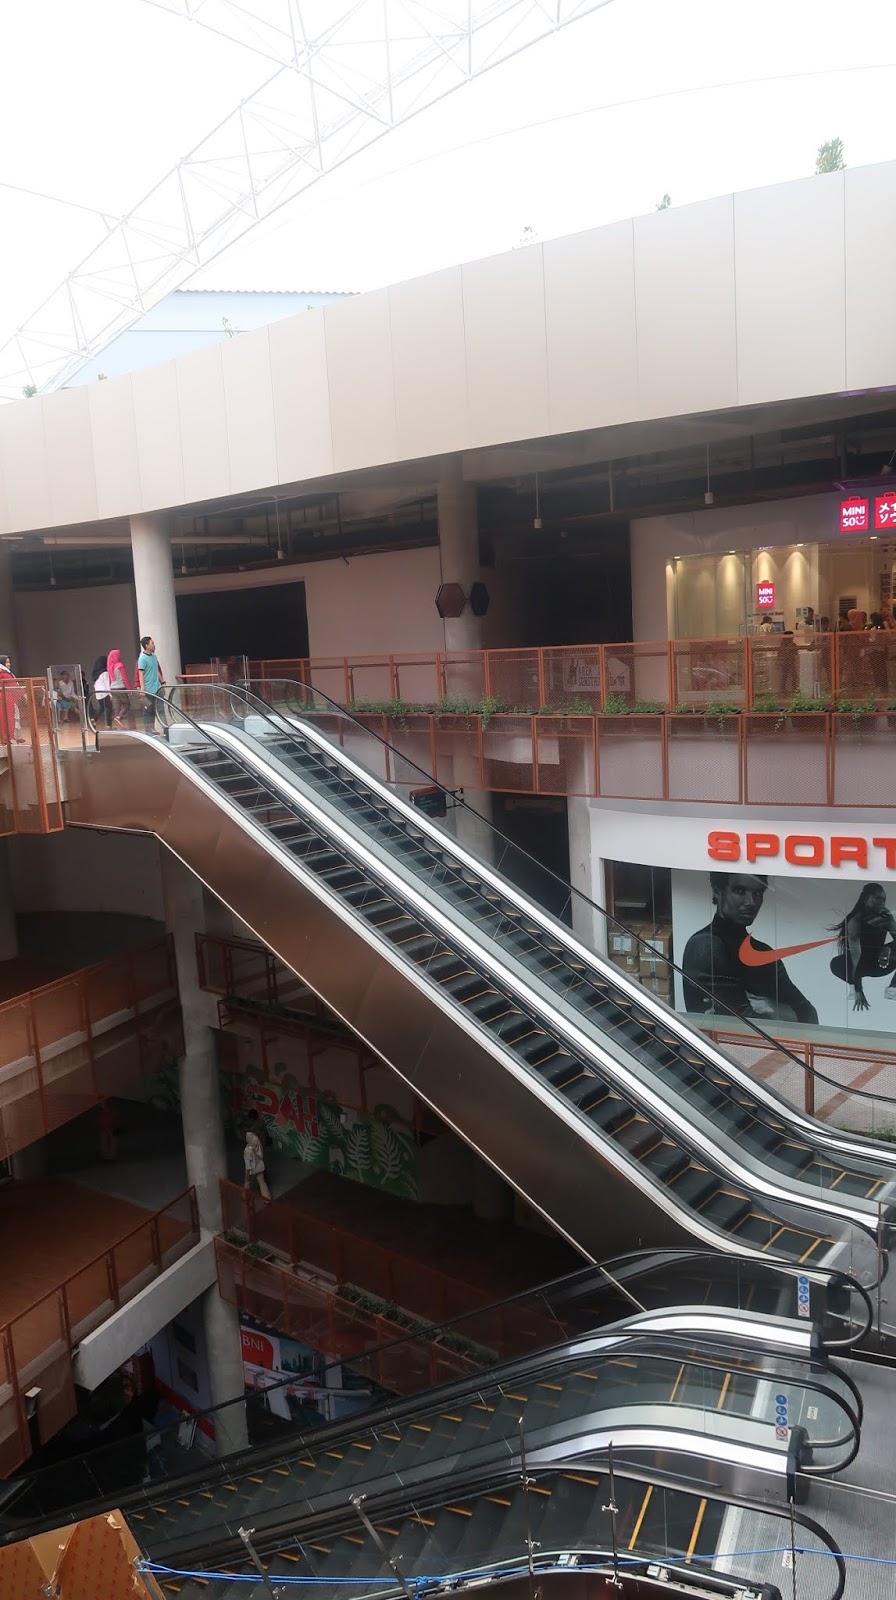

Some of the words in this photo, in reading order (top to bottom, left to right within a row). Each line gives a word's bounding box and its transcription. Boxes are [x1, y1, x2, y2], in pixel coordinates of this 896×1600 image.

[842, 505, 865, 517] MINI
[758, 587, 773, 596] MINI
[707, 831, 896, 868] SPORT
[242, 1335, 264, 1353] BNI
